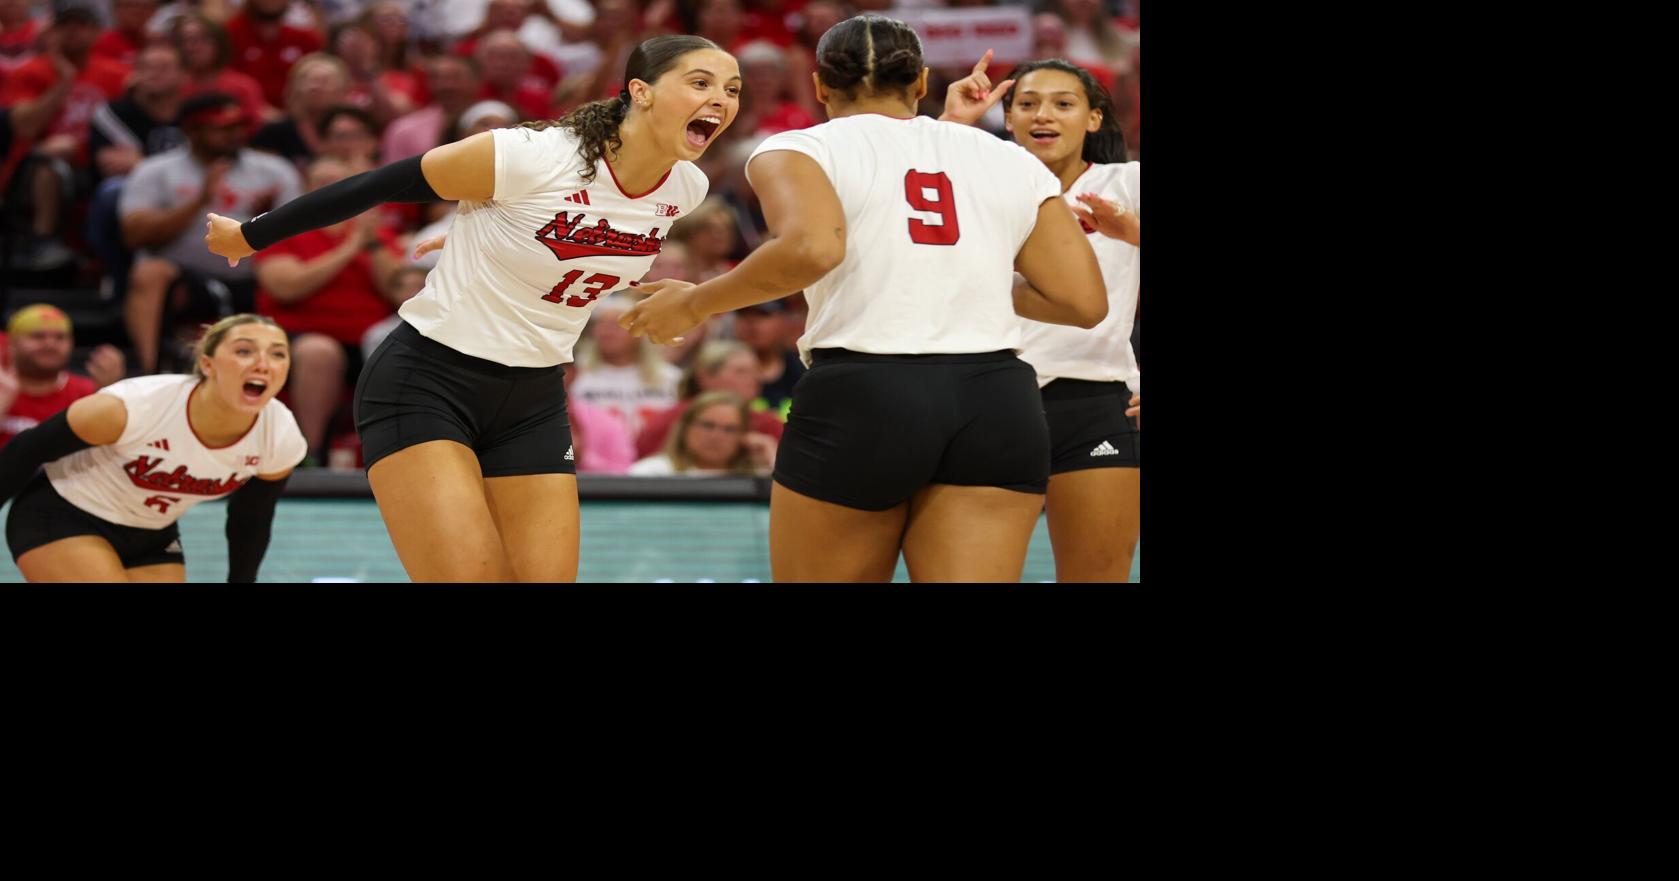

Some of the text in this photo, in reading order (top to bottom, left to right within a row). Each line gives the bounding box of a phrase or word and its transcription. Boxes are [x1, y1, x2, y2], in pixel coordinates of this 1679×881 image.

[905, 168, 960, 246] 9
[535, 210, 665, 251] Nebrask
[541, 269, 621, 308] 13
[123, 455, 243, 493] Nebrask
